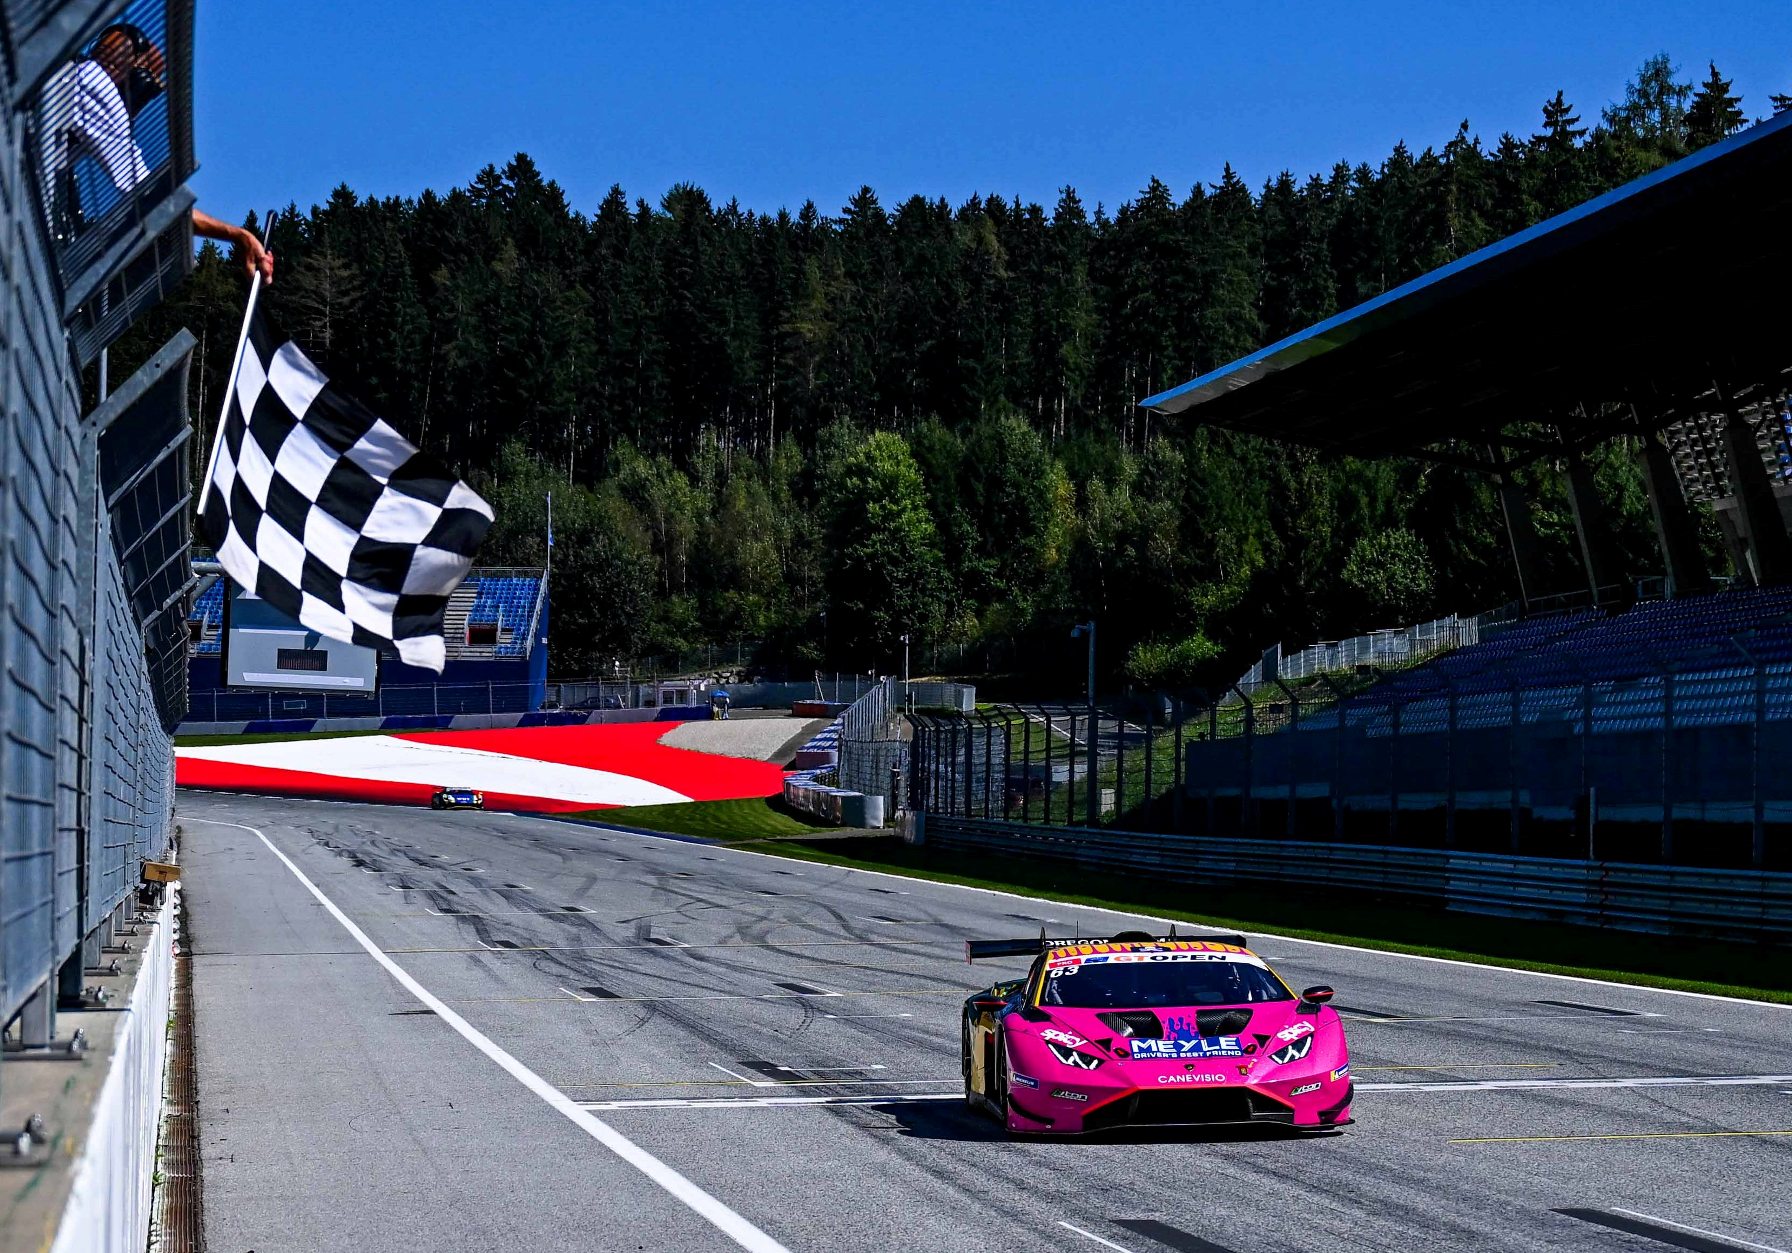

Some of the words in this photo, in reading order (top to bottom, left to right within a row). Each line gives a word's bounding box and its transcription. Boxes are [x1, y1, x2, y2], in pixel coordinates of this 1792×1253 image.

[1042, 939, 1109, 947] OREGO
[1050, 965, 1080, 978] 63
[1277, 1020, 1315, 1042] spicy
[1040, 1028, 1089, 1049] spicy
[1131, 1036, 1240, 1053] MEYLE
[1133, 1051, 1178, 1060] DRIVER'S
[1179, 1050, 1203, 1058] BEST
[1206, 1049, 1242, 1057] FRIEND
[1157, 1073, 1226, 1085] CANEVISIO
